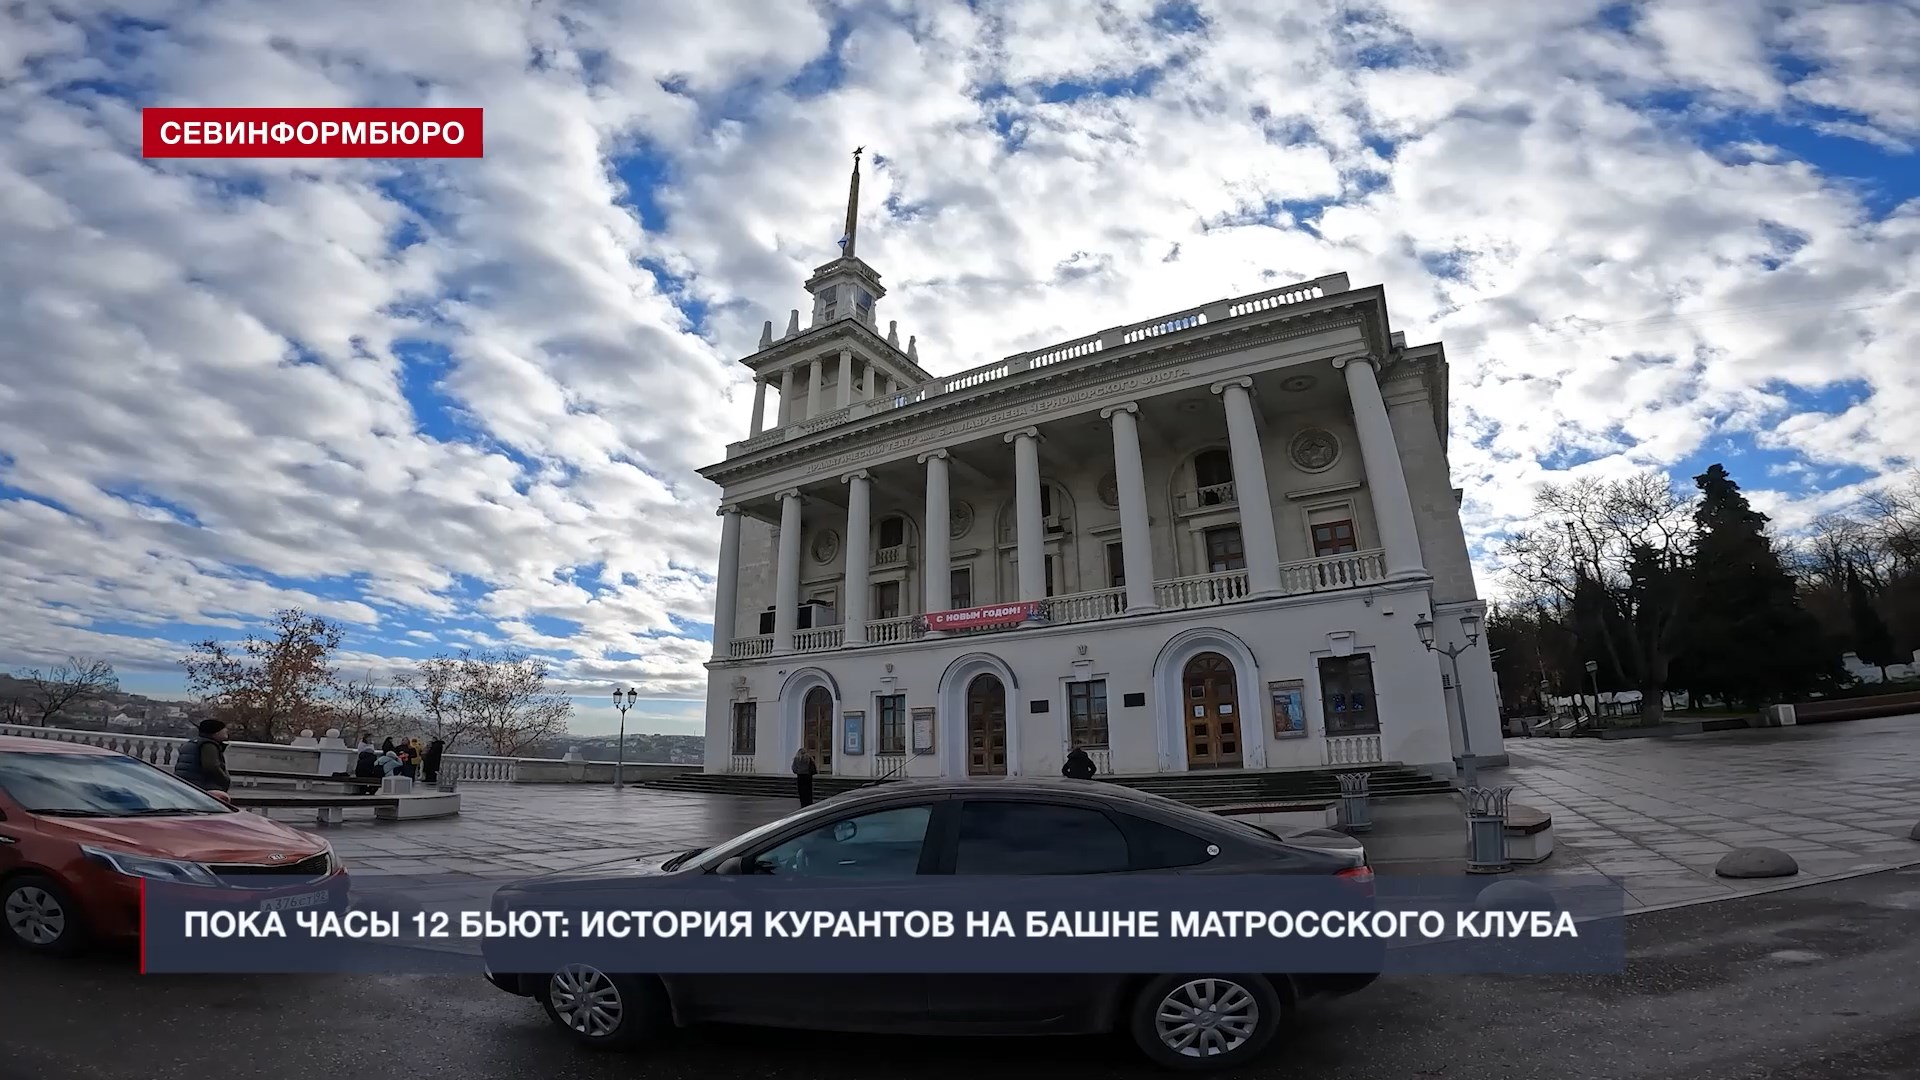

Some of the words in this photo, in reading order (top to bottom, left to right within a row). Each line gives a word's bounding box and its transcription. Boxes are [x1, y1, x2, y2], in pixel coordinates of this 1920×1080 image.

[807, 443, 886, 474] ДРАМАТИЧЕСКИЙ
[886, 435, 918, 452] ТЕАТР
[960, 406, 1028, 433] ЛАВРЕНЕВА
[1029, 377, 1139, 413] ЧЕРНОМОРСКОГО
[1141, 367, 1191, 386] ФЛОТА
[936, 614, 944, 624] С
[945, 610, 981, 623] НОВЫМ
[982, 605, 1021, 619] ГОДОМ!
